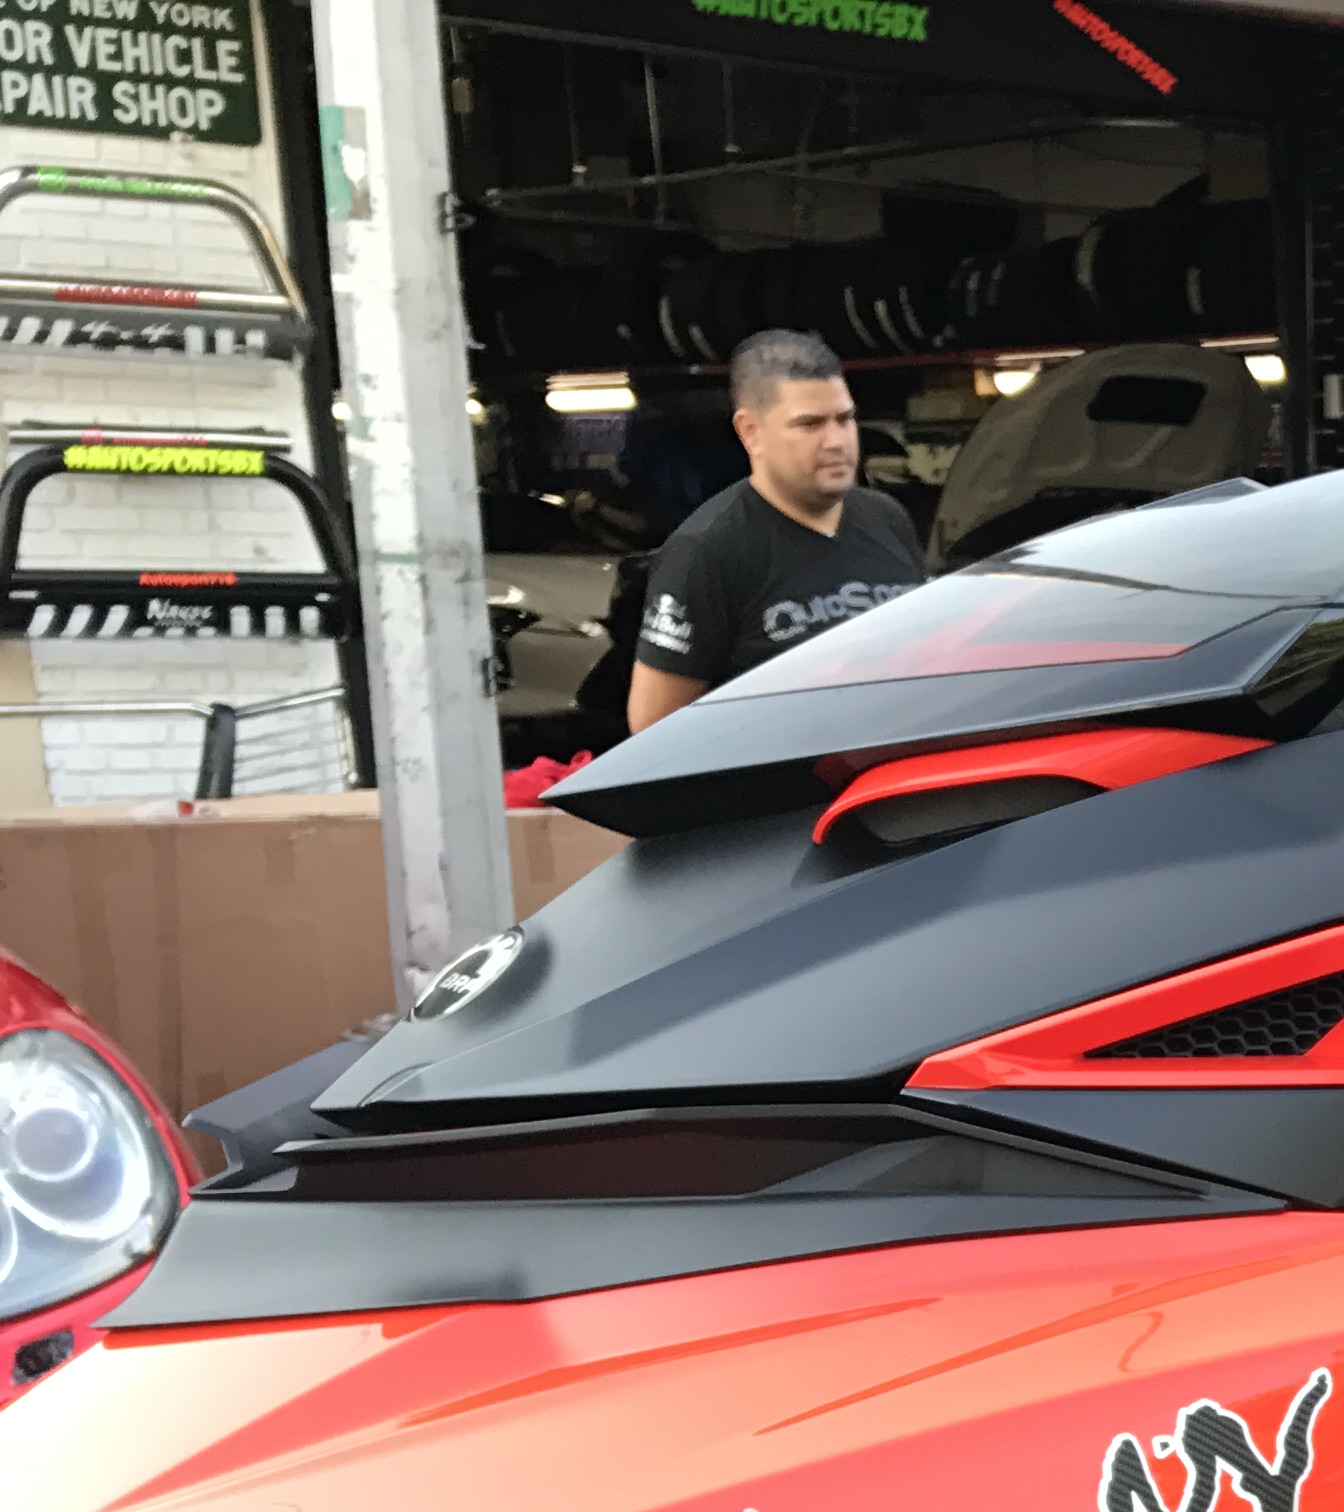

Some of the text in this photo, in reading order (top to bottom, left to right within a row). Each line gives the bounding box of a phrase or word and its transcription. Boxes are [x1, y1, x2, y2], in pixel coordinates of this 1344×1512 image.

[150, 2, 235, 31] YORK
[64, 24, 246, 83] VEHICLE
[112, 80, 226, 131] SHOP
